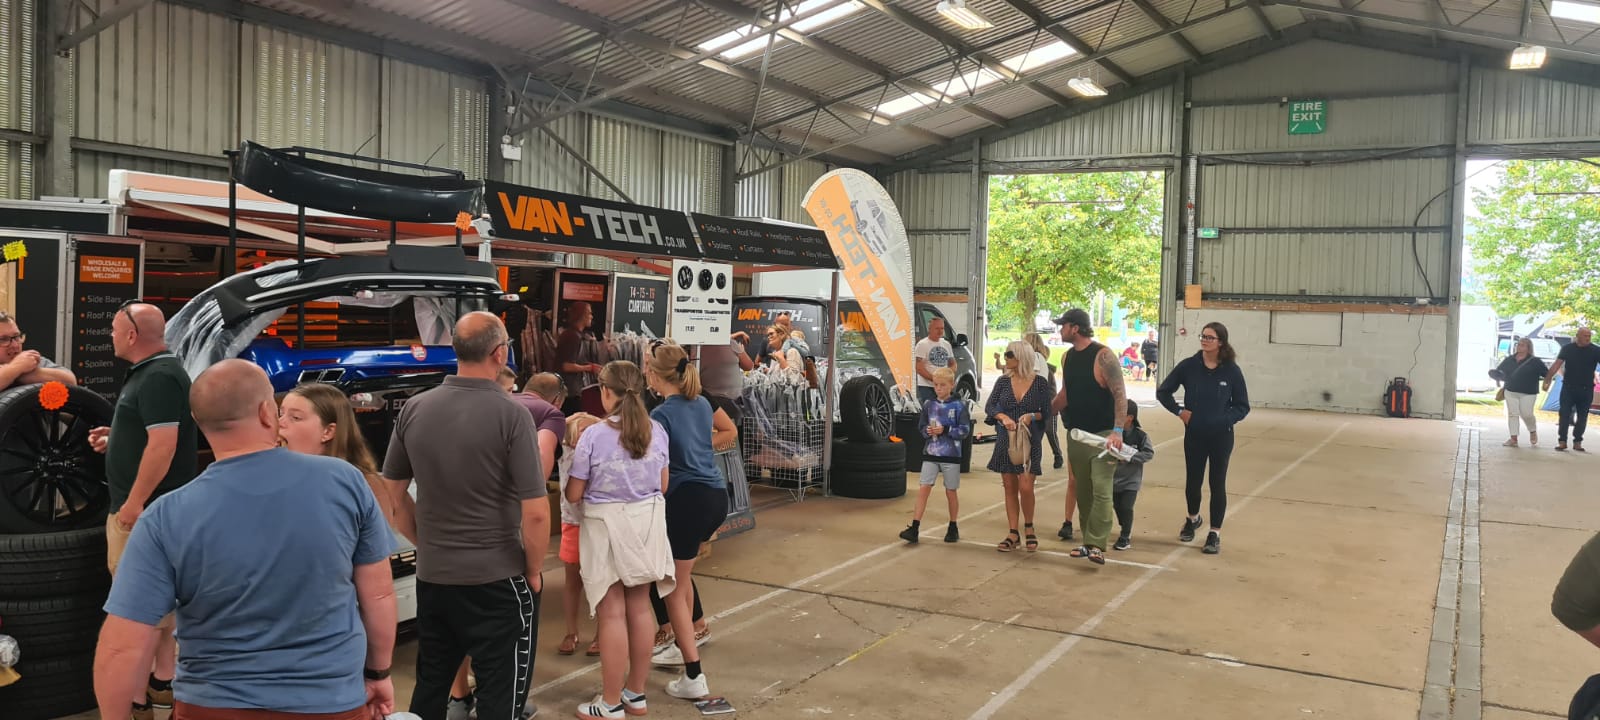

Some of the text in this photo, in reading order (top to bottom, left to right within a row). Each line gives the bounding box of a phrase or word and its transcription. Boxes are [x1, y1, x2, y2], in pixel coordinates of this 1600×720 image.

[1293, 101, 1323, 111] FIRE
[1292, 112, 1322, 122] EXIT
[497, 191, 664, 246] VAN-TECH
[87, 259, 121, 267] WHOLESALE
[102, 266, 132, 274] ENQUIRIES
[87, 294, 122, 304] Side Bars
[628, 300, 655, 314] CURTAINS
[86, 311, 105, 320] Roof
[86, 328, 112, 338] Headlig
[85, 343, 113, 352] Facelift
[84, 360, 114, 369] Spoilers
[84, 376, 114, 385] Curtains
